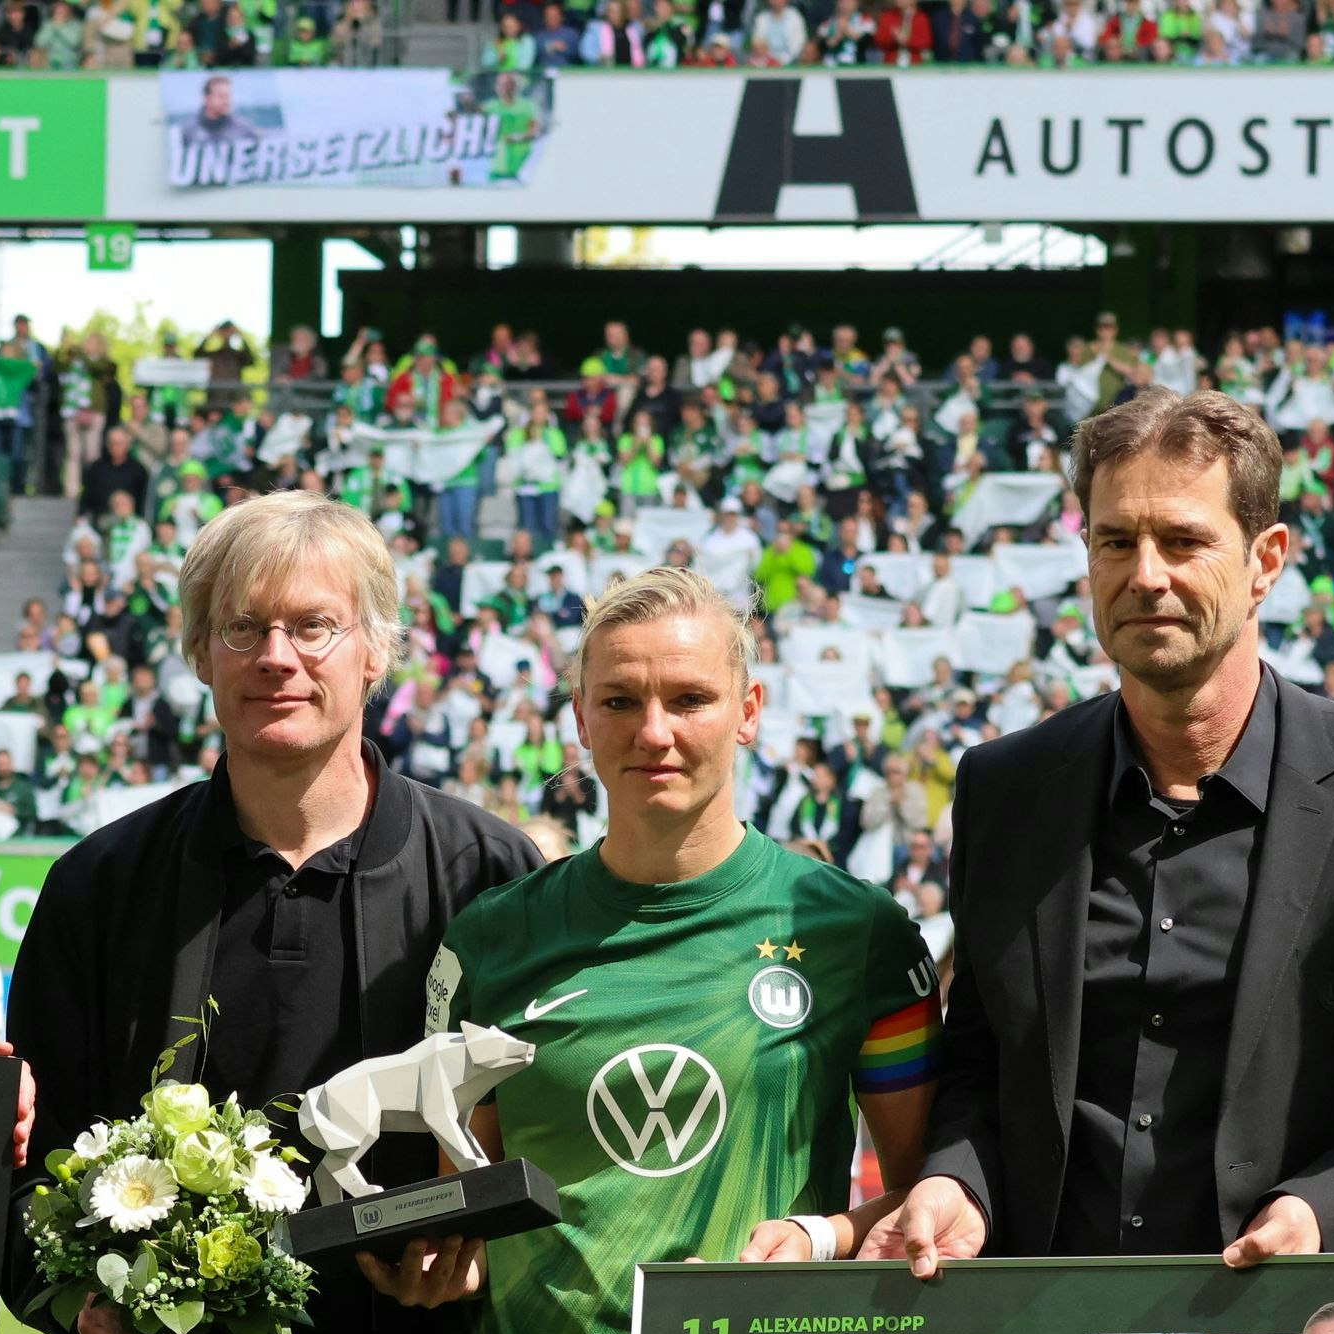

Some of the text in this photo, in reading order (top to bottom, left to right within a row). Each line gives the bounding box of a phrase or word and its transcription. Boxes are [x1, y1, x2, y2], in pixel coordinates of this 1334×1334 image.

[170, 113, 500, 187] UNERSETZLICH!
[92, 233, 131, 262] 19
[748, 1316, 925, 1333] ALEXANDRA POPP
